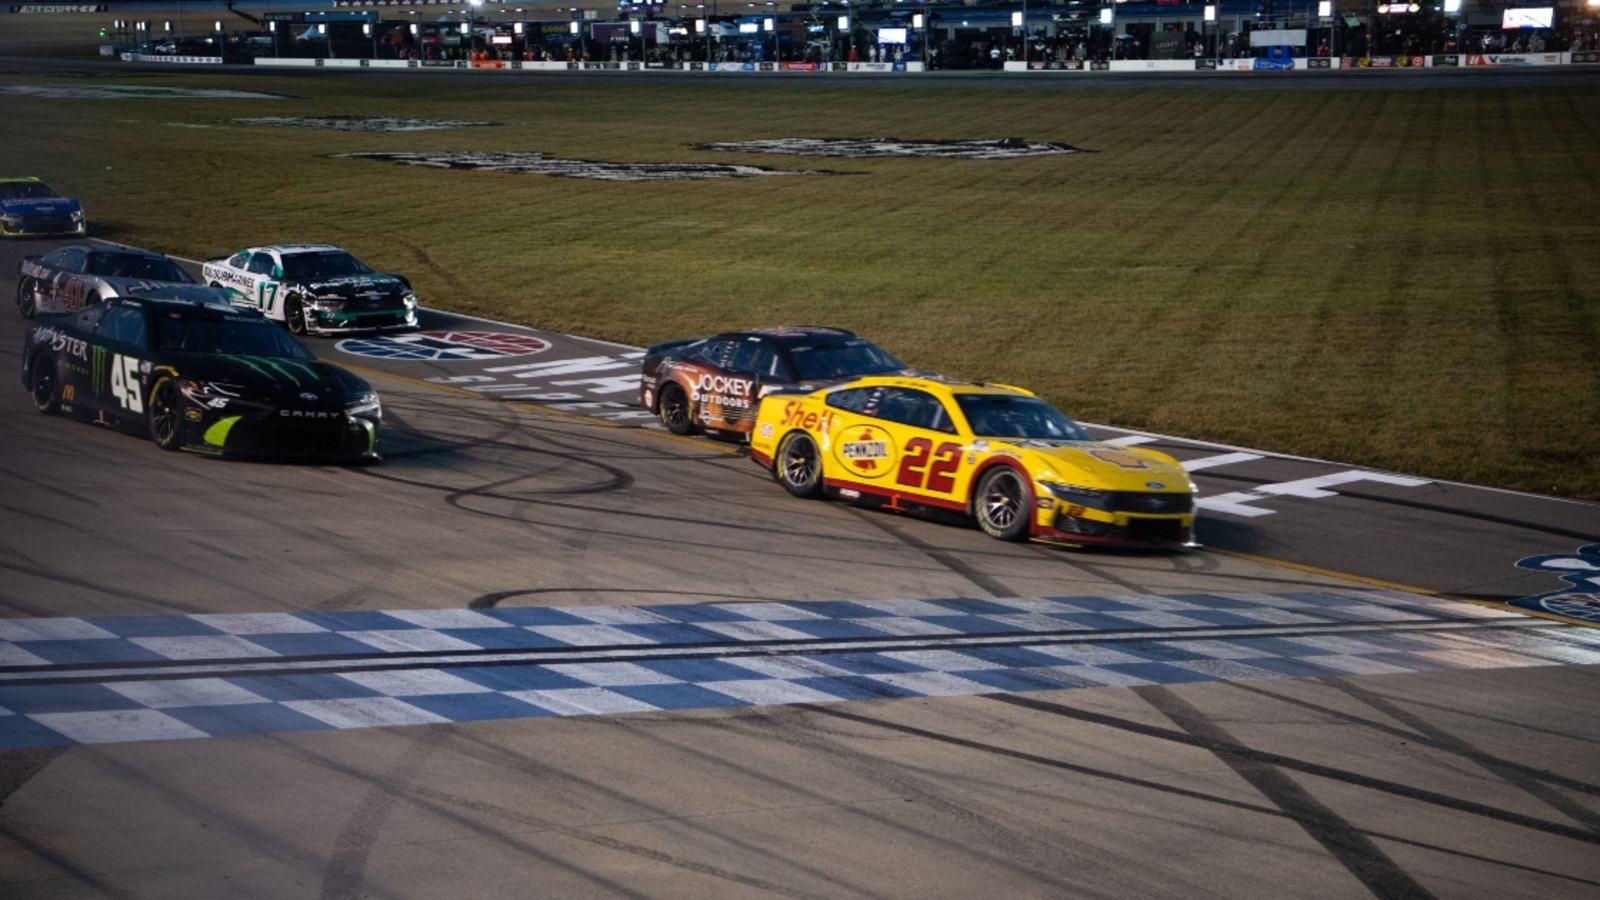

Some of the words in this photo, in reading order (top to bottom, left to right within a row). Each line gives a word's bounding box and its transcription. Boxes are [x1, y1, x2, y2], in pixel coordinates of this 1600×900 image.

[541, 24, 590, 33] GOODR
[62, 276, 85, 312] 41
[258, 280, 281, 313] 17
[32, 326, 88, 362] MONSTER
[110, 353, 144, 414] 45
[689, 373, 754, 397] JOCKEY
[207, 396, 230, 409] 45
[279, 409, 341, 418] CAMRY
[691, 391, 752, 410] OUTDOORS
[780, 400, 835, 433] Shell
[843, 441, 887, 457] PENNZOIL
[896, 436, 964, 494] 22
